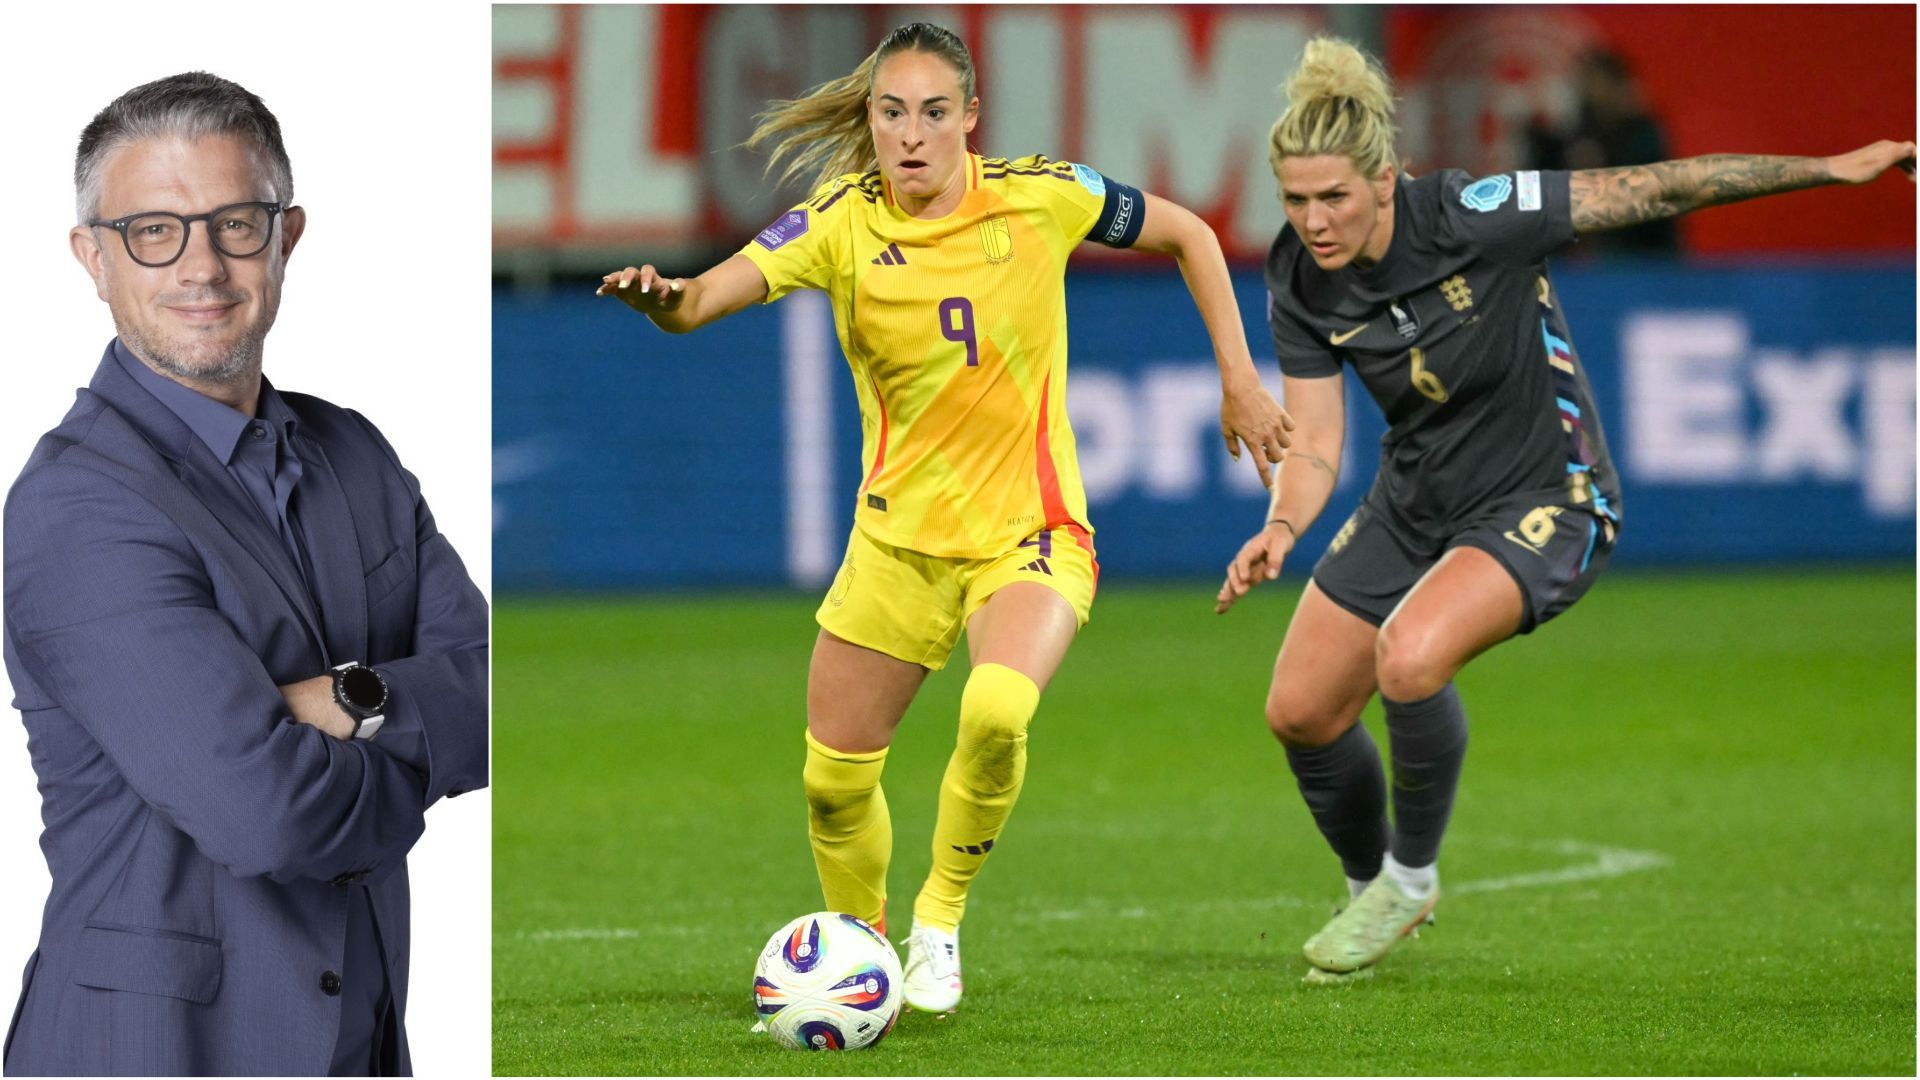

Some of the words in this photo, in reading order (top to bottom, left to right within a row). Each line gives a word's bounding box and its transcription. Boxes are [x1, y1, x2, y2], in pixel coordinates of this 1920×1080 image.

[1106, 193, 1131, 242] RESPECT
[938, 296, 979, 367] 9
[1409, 347, 1449, 403] 6
[1519, 505, 1565, 548] 6
